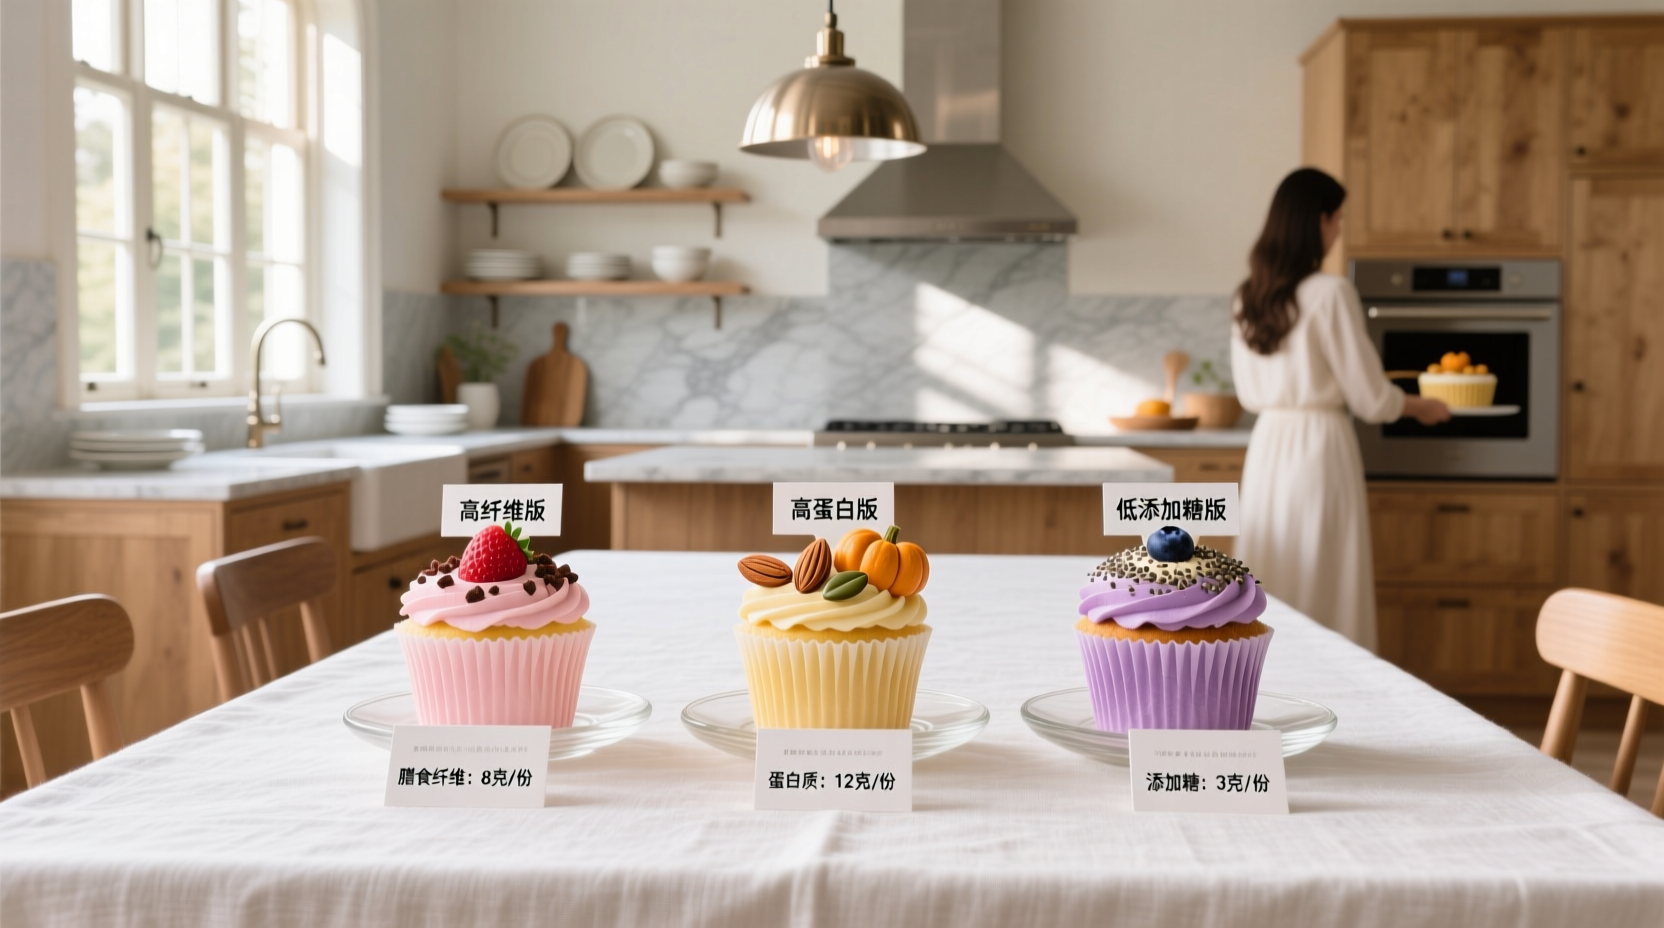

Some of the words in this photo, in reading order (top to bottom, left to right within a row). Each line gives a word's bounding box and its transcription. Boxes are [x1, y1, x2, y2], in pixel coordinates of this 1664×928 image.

[459, 498, 545, 522] 高纤维版
[790, 496, 878, 521] 高蛋白版
[1116, 497, 1227, 521] 低添加糖版
